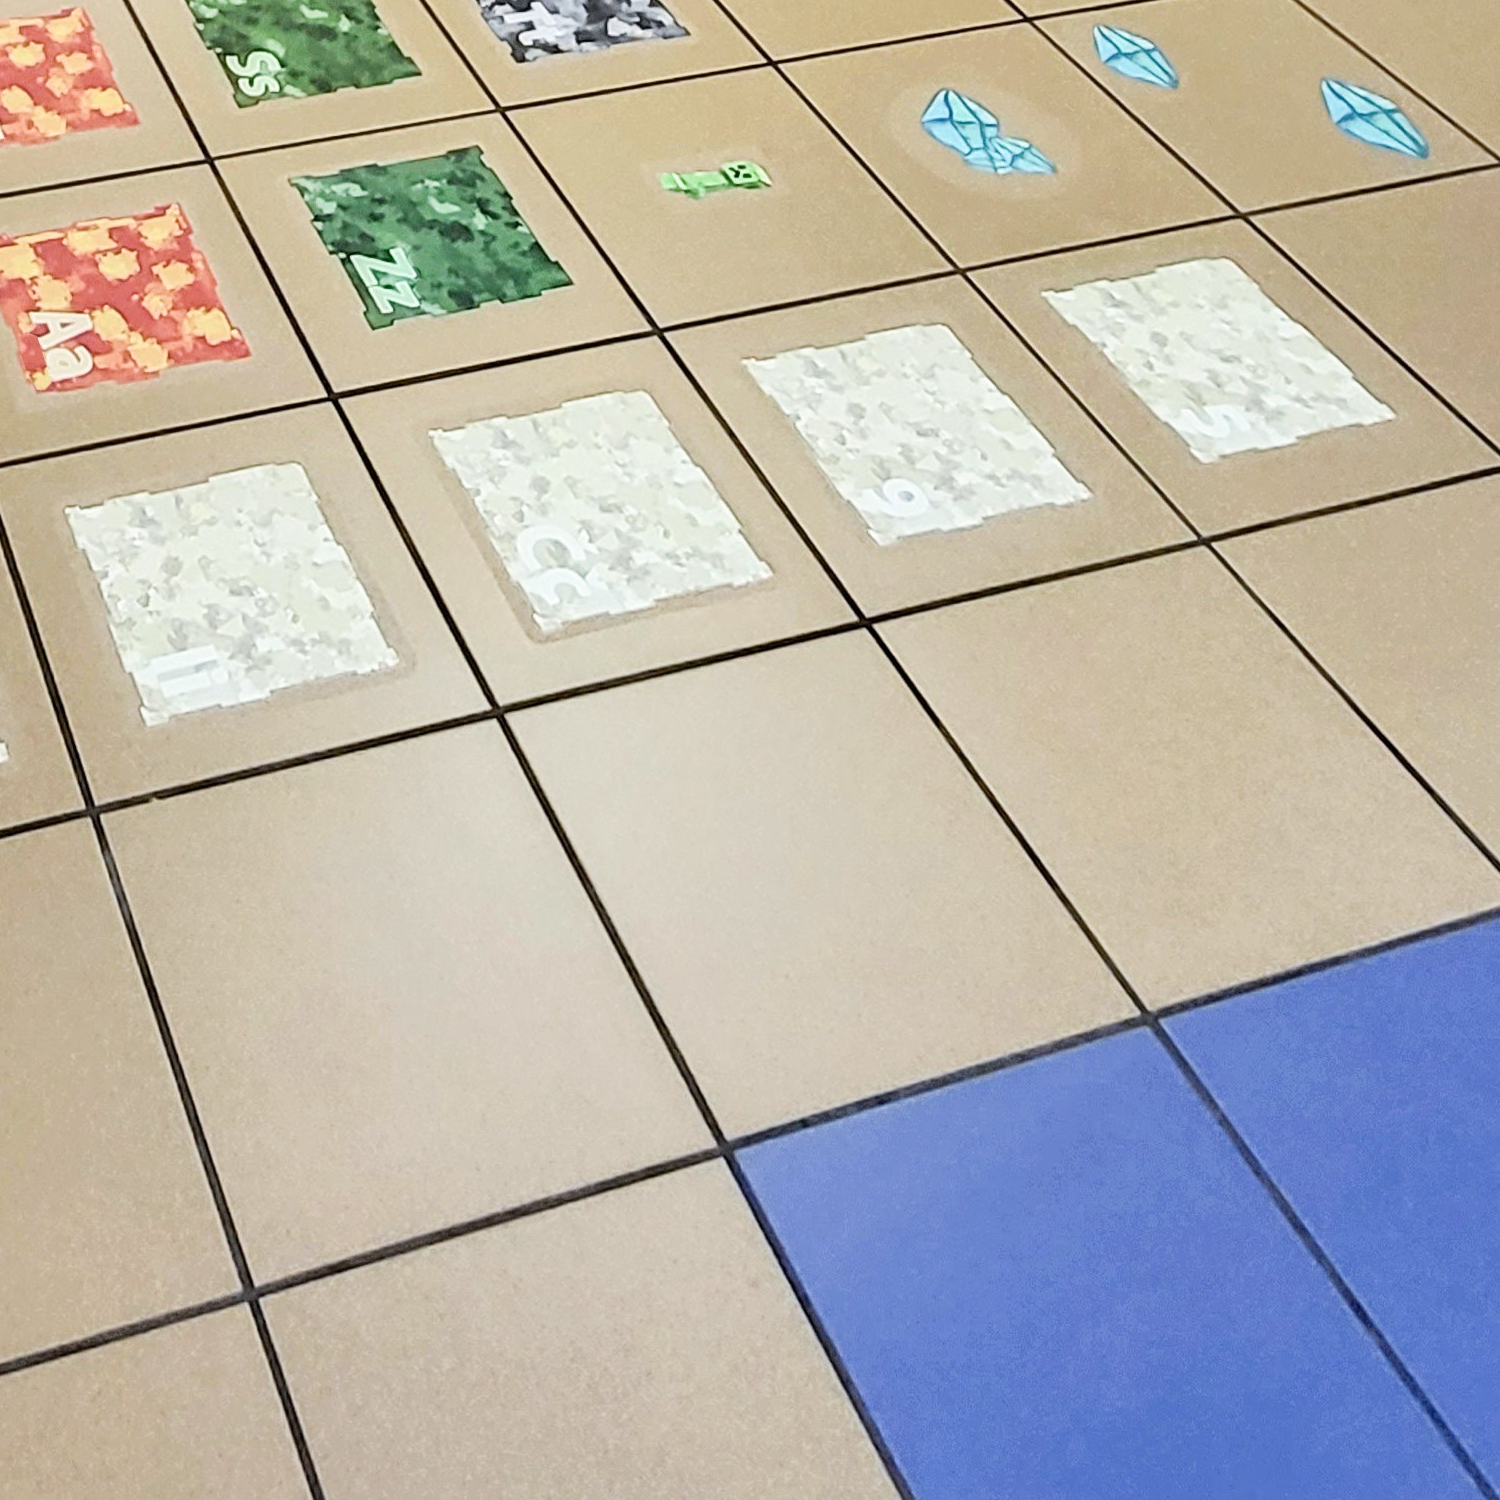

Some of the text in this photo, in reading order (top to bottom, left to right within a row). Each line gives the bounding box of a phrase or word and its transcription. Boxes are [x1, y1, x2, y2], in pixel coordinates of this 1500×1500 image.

[225, 52, 284, 97] Ss
[350, 247, 420, 313] Zz
[28, 311, 95, 382] Aa
[1179, 404, 1251, 438] 5
[860, 478, 928, 517] 9
